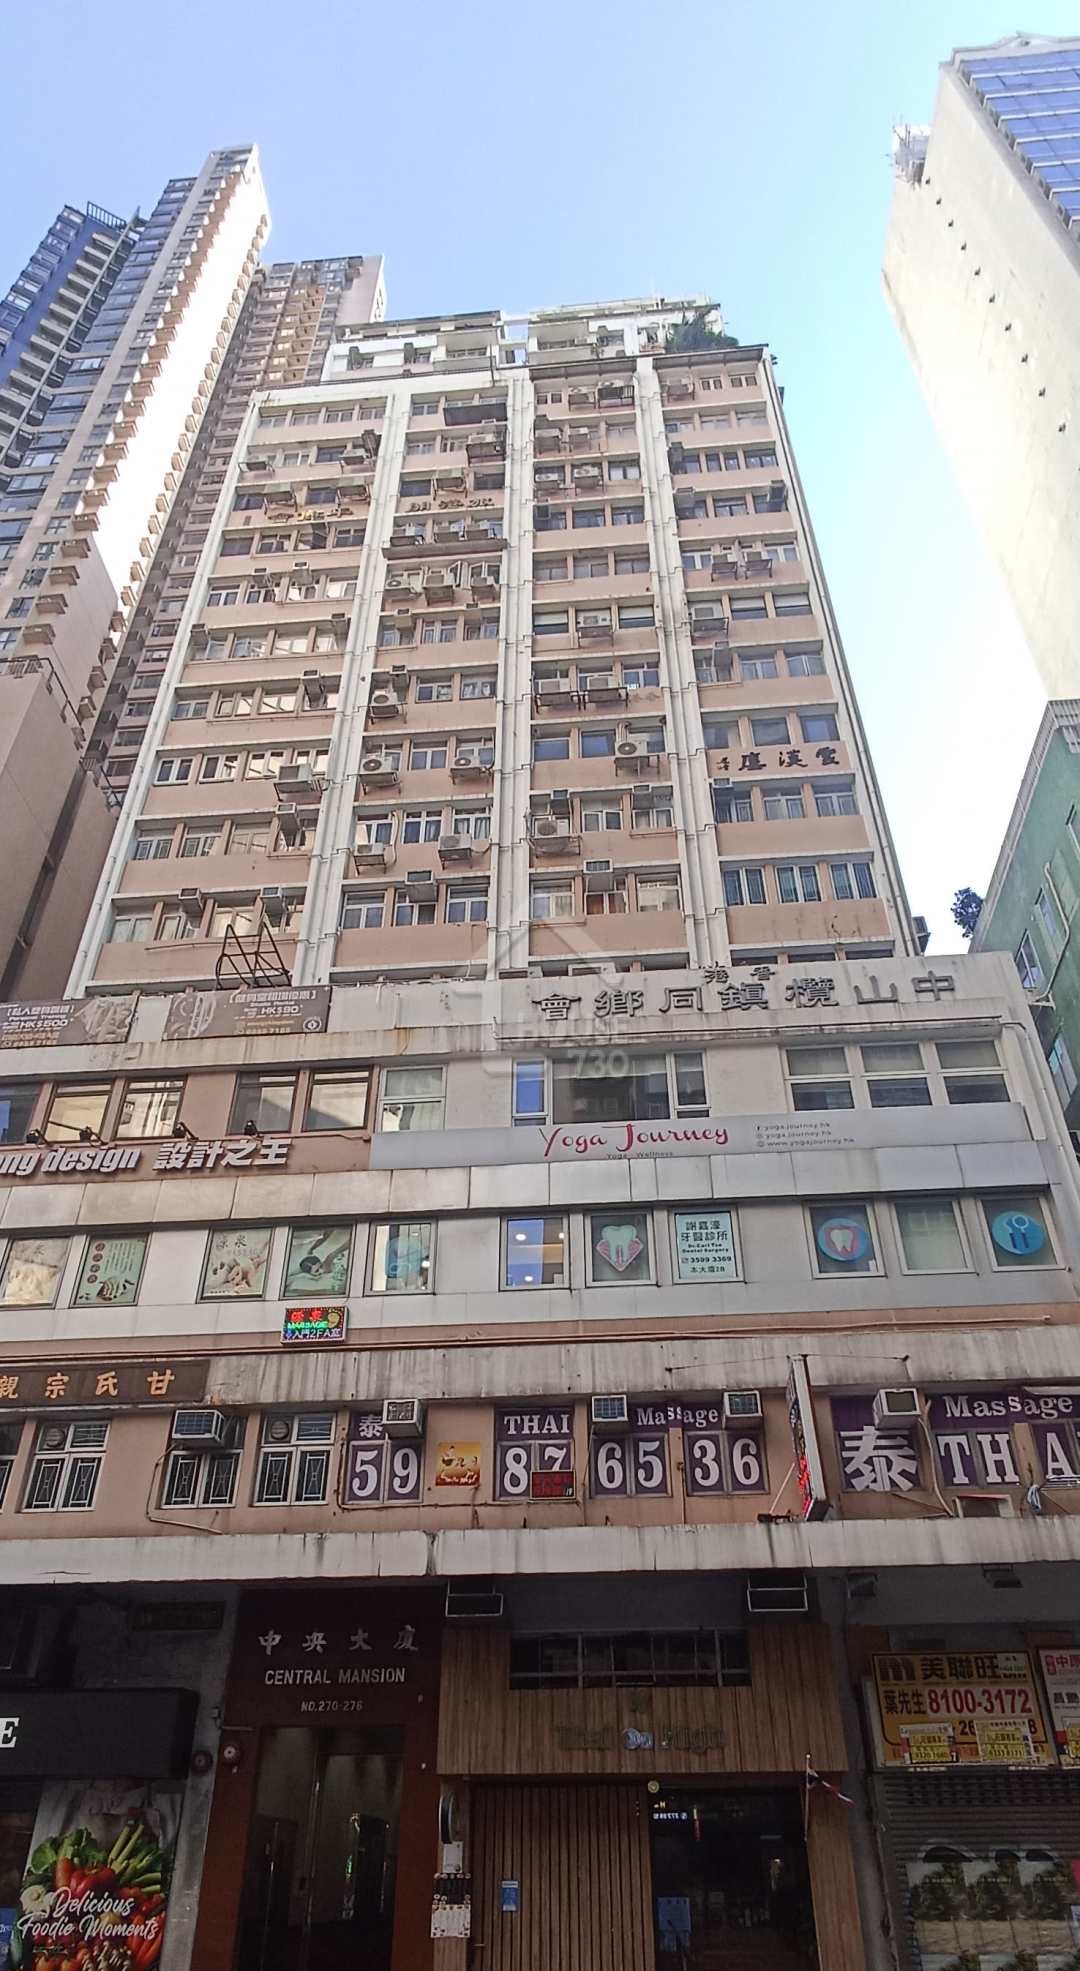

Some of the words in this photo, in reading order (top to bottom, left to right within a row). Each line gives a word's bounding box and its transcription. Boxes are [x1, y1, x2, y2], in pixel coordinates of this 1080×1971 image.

[154, 1138, 293, 1170] 設計之王
[538, 1127, 608, 1157] Yoga
[602, 1123, 729, 1152] Journey
[41, 1147, 142, 1173] design
[637, 1406, 720, 1428] Massage
[941, 1394, 1073, 1420] Massage
[504, 1414, 571, 1435] THAI
[839, 1425, 918, 1492] 泰
[257, 1624, 420, 1656] 中央大廈
[264, 1669, 332, 1686] CENTRAL
[338, 1667, 407, 1684] MANSION
[927, 1688, 1033, 1714] 8100-3172
[52, 1885, 136, 1917] Delicious
[16, 1910, 76, 1940] Foodie
[79, 1914, 160, 1941] Moments
